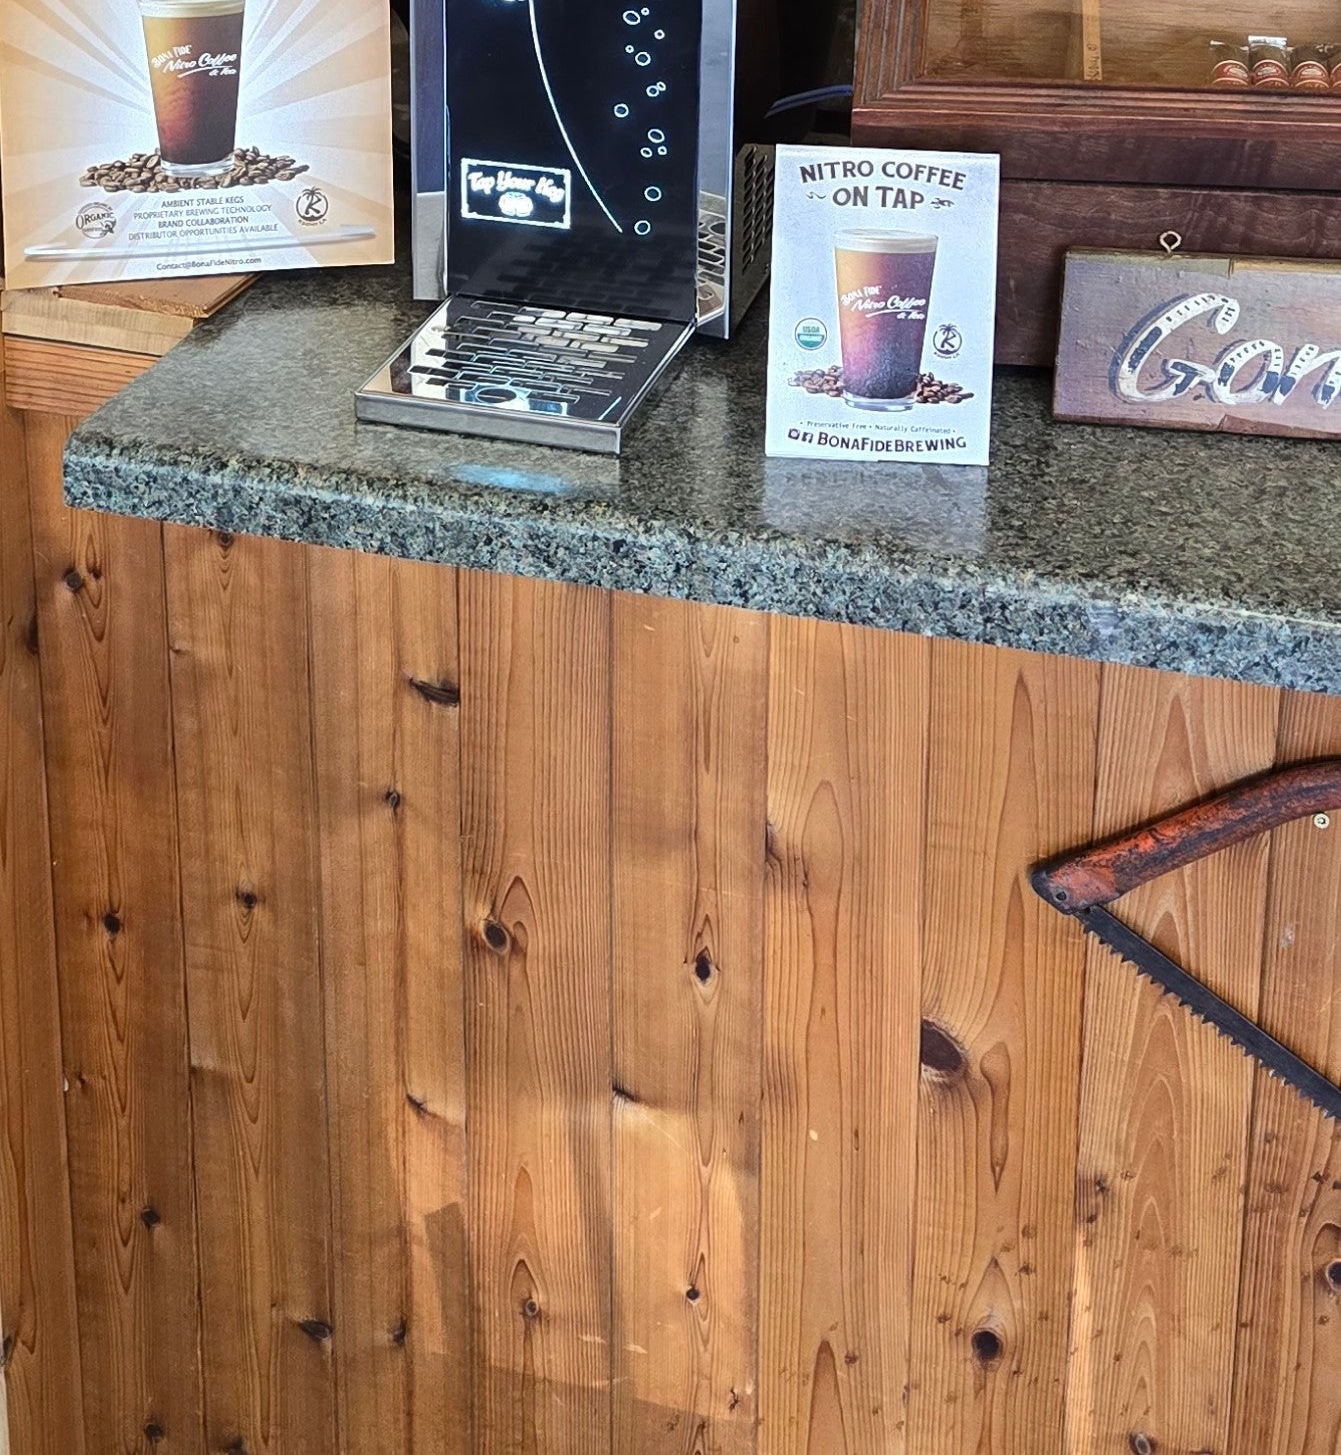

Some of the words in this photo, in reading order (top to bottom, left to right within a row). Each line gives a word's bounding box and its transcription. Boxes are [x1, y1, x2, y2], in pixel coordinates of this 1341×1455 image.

[163, 59, 196, 73] Nitro
[198, 53, 237, 67] Coffee
[220, 68, 236, 76] Tea
[799, 160, 874, 184] NITRO
[881, 161, 967, 191] COFFEE
[467, 171, 495, 195] Tap
[496, 170, 536, 192] Your
[535, 176, 565, 203] Keg
[161, 199, 194, 208] AMBIENT
[196, 197, 223, 206] STABLE
[225, 196, 244, 204] KEGS
[832, 186, 869, 207] ON
[875, 185, 925, 210] TAP
[133, 209, 183, 220] PROPRIETARY
[186, 207, 219, 216] BREWING
[221, 204, 272, 214] TECHNOLOGY
[158, 219, 183, 228] BRAND
[185, 216, 249, 227] COLLABORATION
[128, 230, 178, 241] DISTRIBUTOR
[179, 227, 237, 237] OPPORTUNITIES
[239, 224, 278, 233] AVAILABLE
[156, 257, 261, 270] Contact@BonaFideNitro.com
[851, 298, 885, 312] Nitro
[887, 295, 926, 310] Coffee
[807, 421, 849, 430] Preservative
[875, 424, 908, 433] Naturally
[910, 426, 951, 434] Caffeinated
[817, 431, 967, 454] BONAFIDEBREWING
